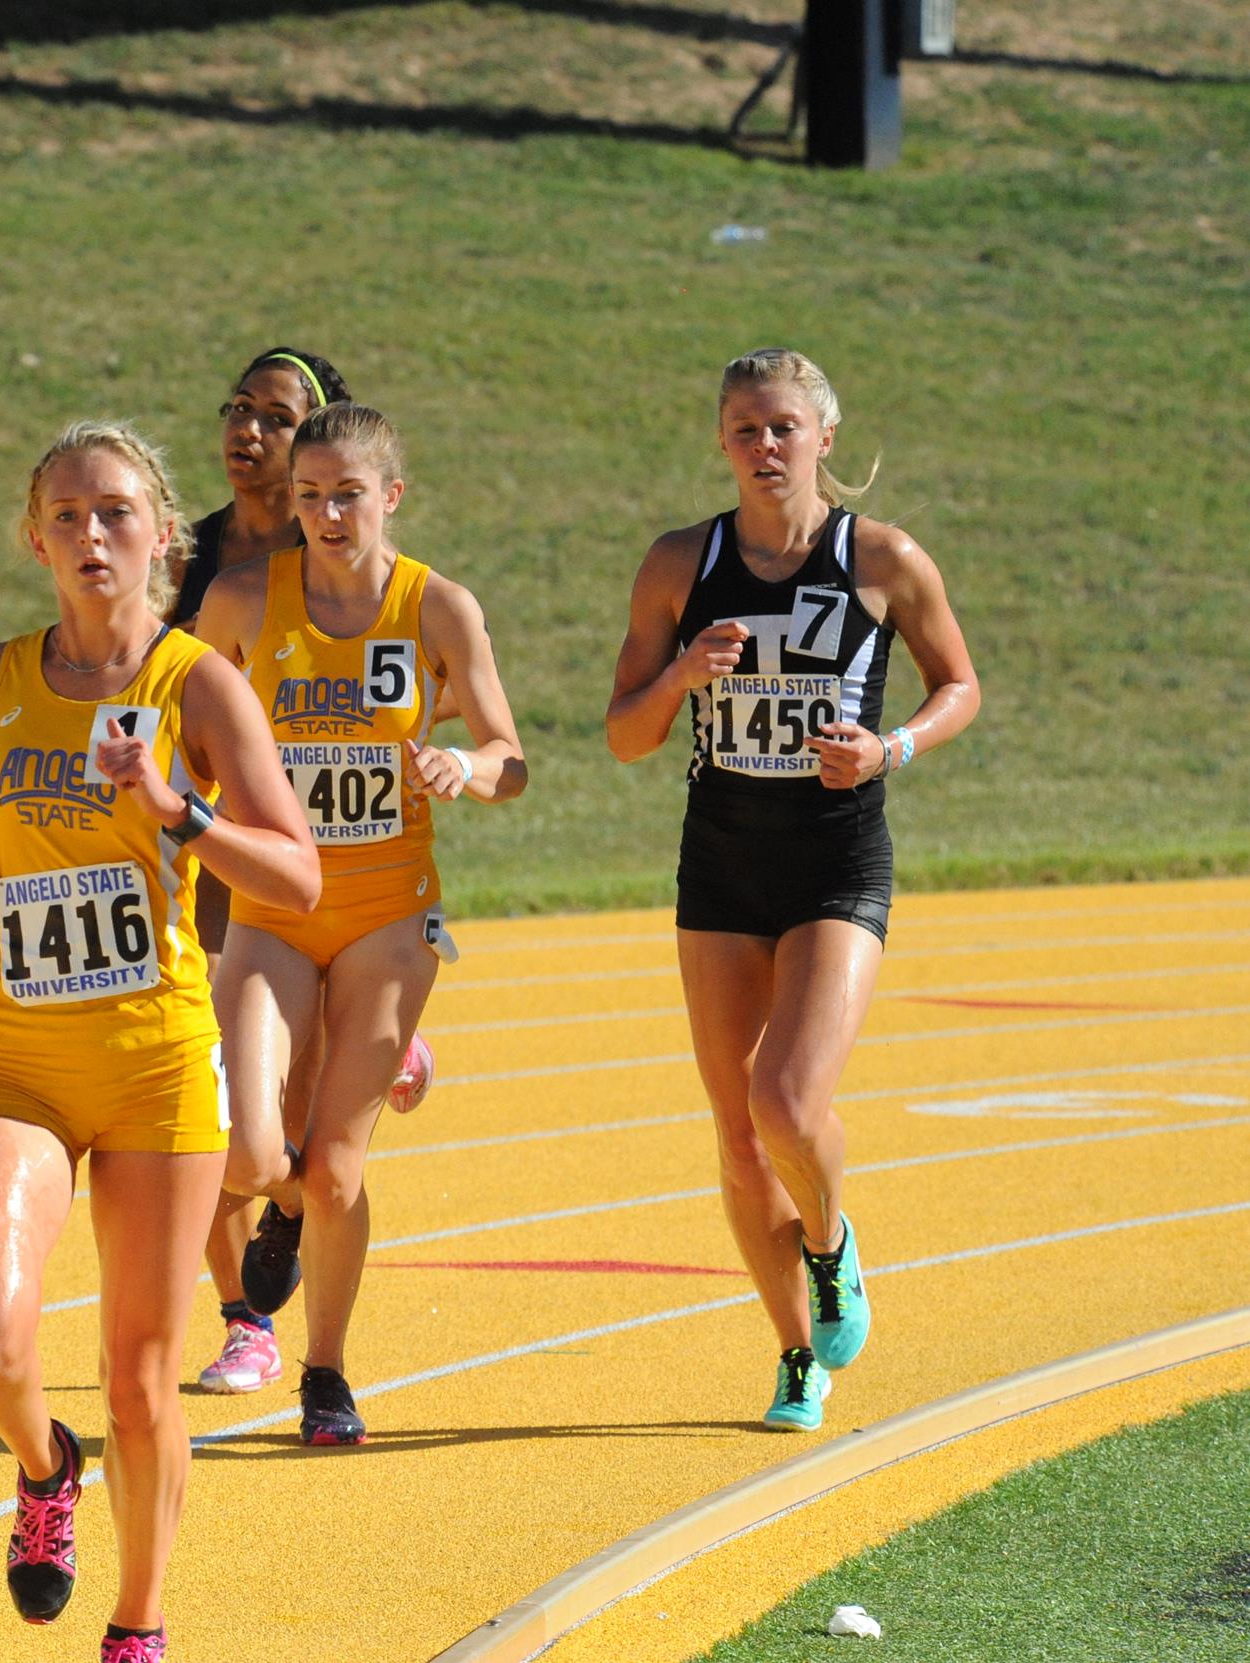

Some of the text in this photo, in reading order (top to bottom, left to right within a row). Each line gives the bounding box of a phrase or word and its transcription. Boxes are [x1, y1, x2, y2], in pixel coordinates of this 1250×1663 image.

[800, 593, 839, 651] 7
[369, 644, 406, 703] 5
[720, 677, 832, 696] ANGELO STATE
[289, 720, 357, 737] STATE
[716, 697, 836, 756] 1459
[282, 746, 392, 765] ANGELO STATE
[720, 755, 822, 770] UNIVERSIT
[285, 767, 398, 824] 402
[16, 801, 95, 831] STATE
[5, 866, 135, 907] ANGELO STATE
[2, 893, 150, 981] 1416
[11, 964, 147, 998] UNIVERSITY
